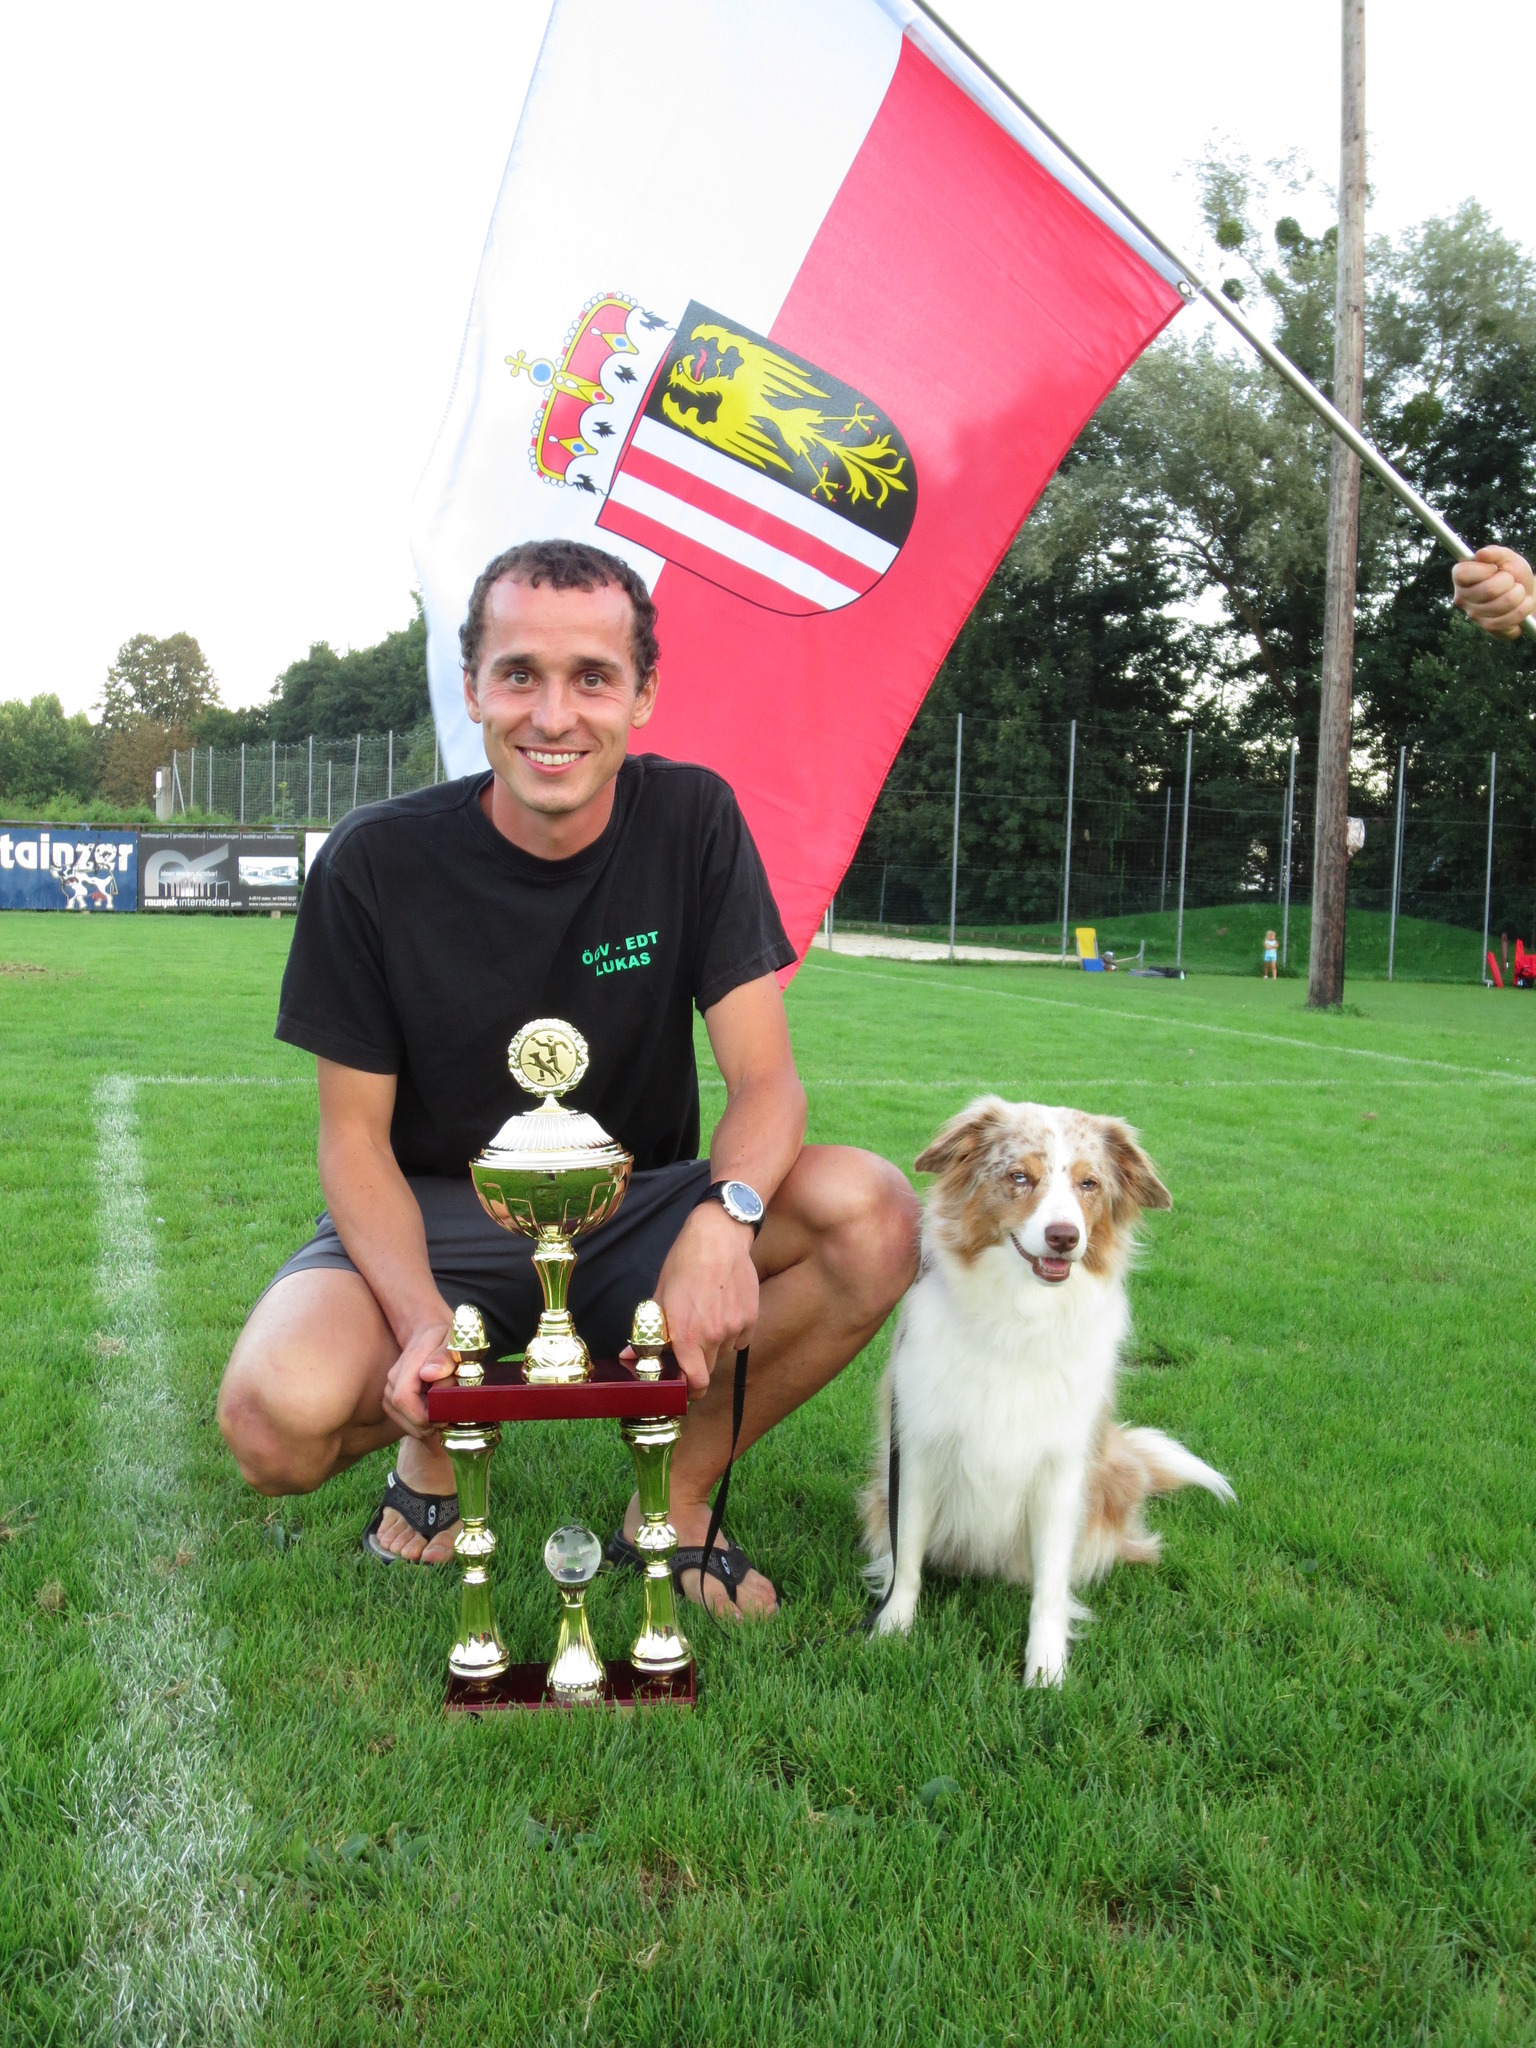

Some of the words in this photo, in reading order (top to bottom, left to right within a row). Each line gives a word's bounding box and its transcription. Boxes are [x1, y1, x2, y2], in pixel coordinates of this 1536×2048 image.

[144, 896, 178, 909] raunjak
[179, 896, 230, 907] intermedias
[625, 930, 659, 951] EDT
[595, 951, 651, 977] LUKAS
